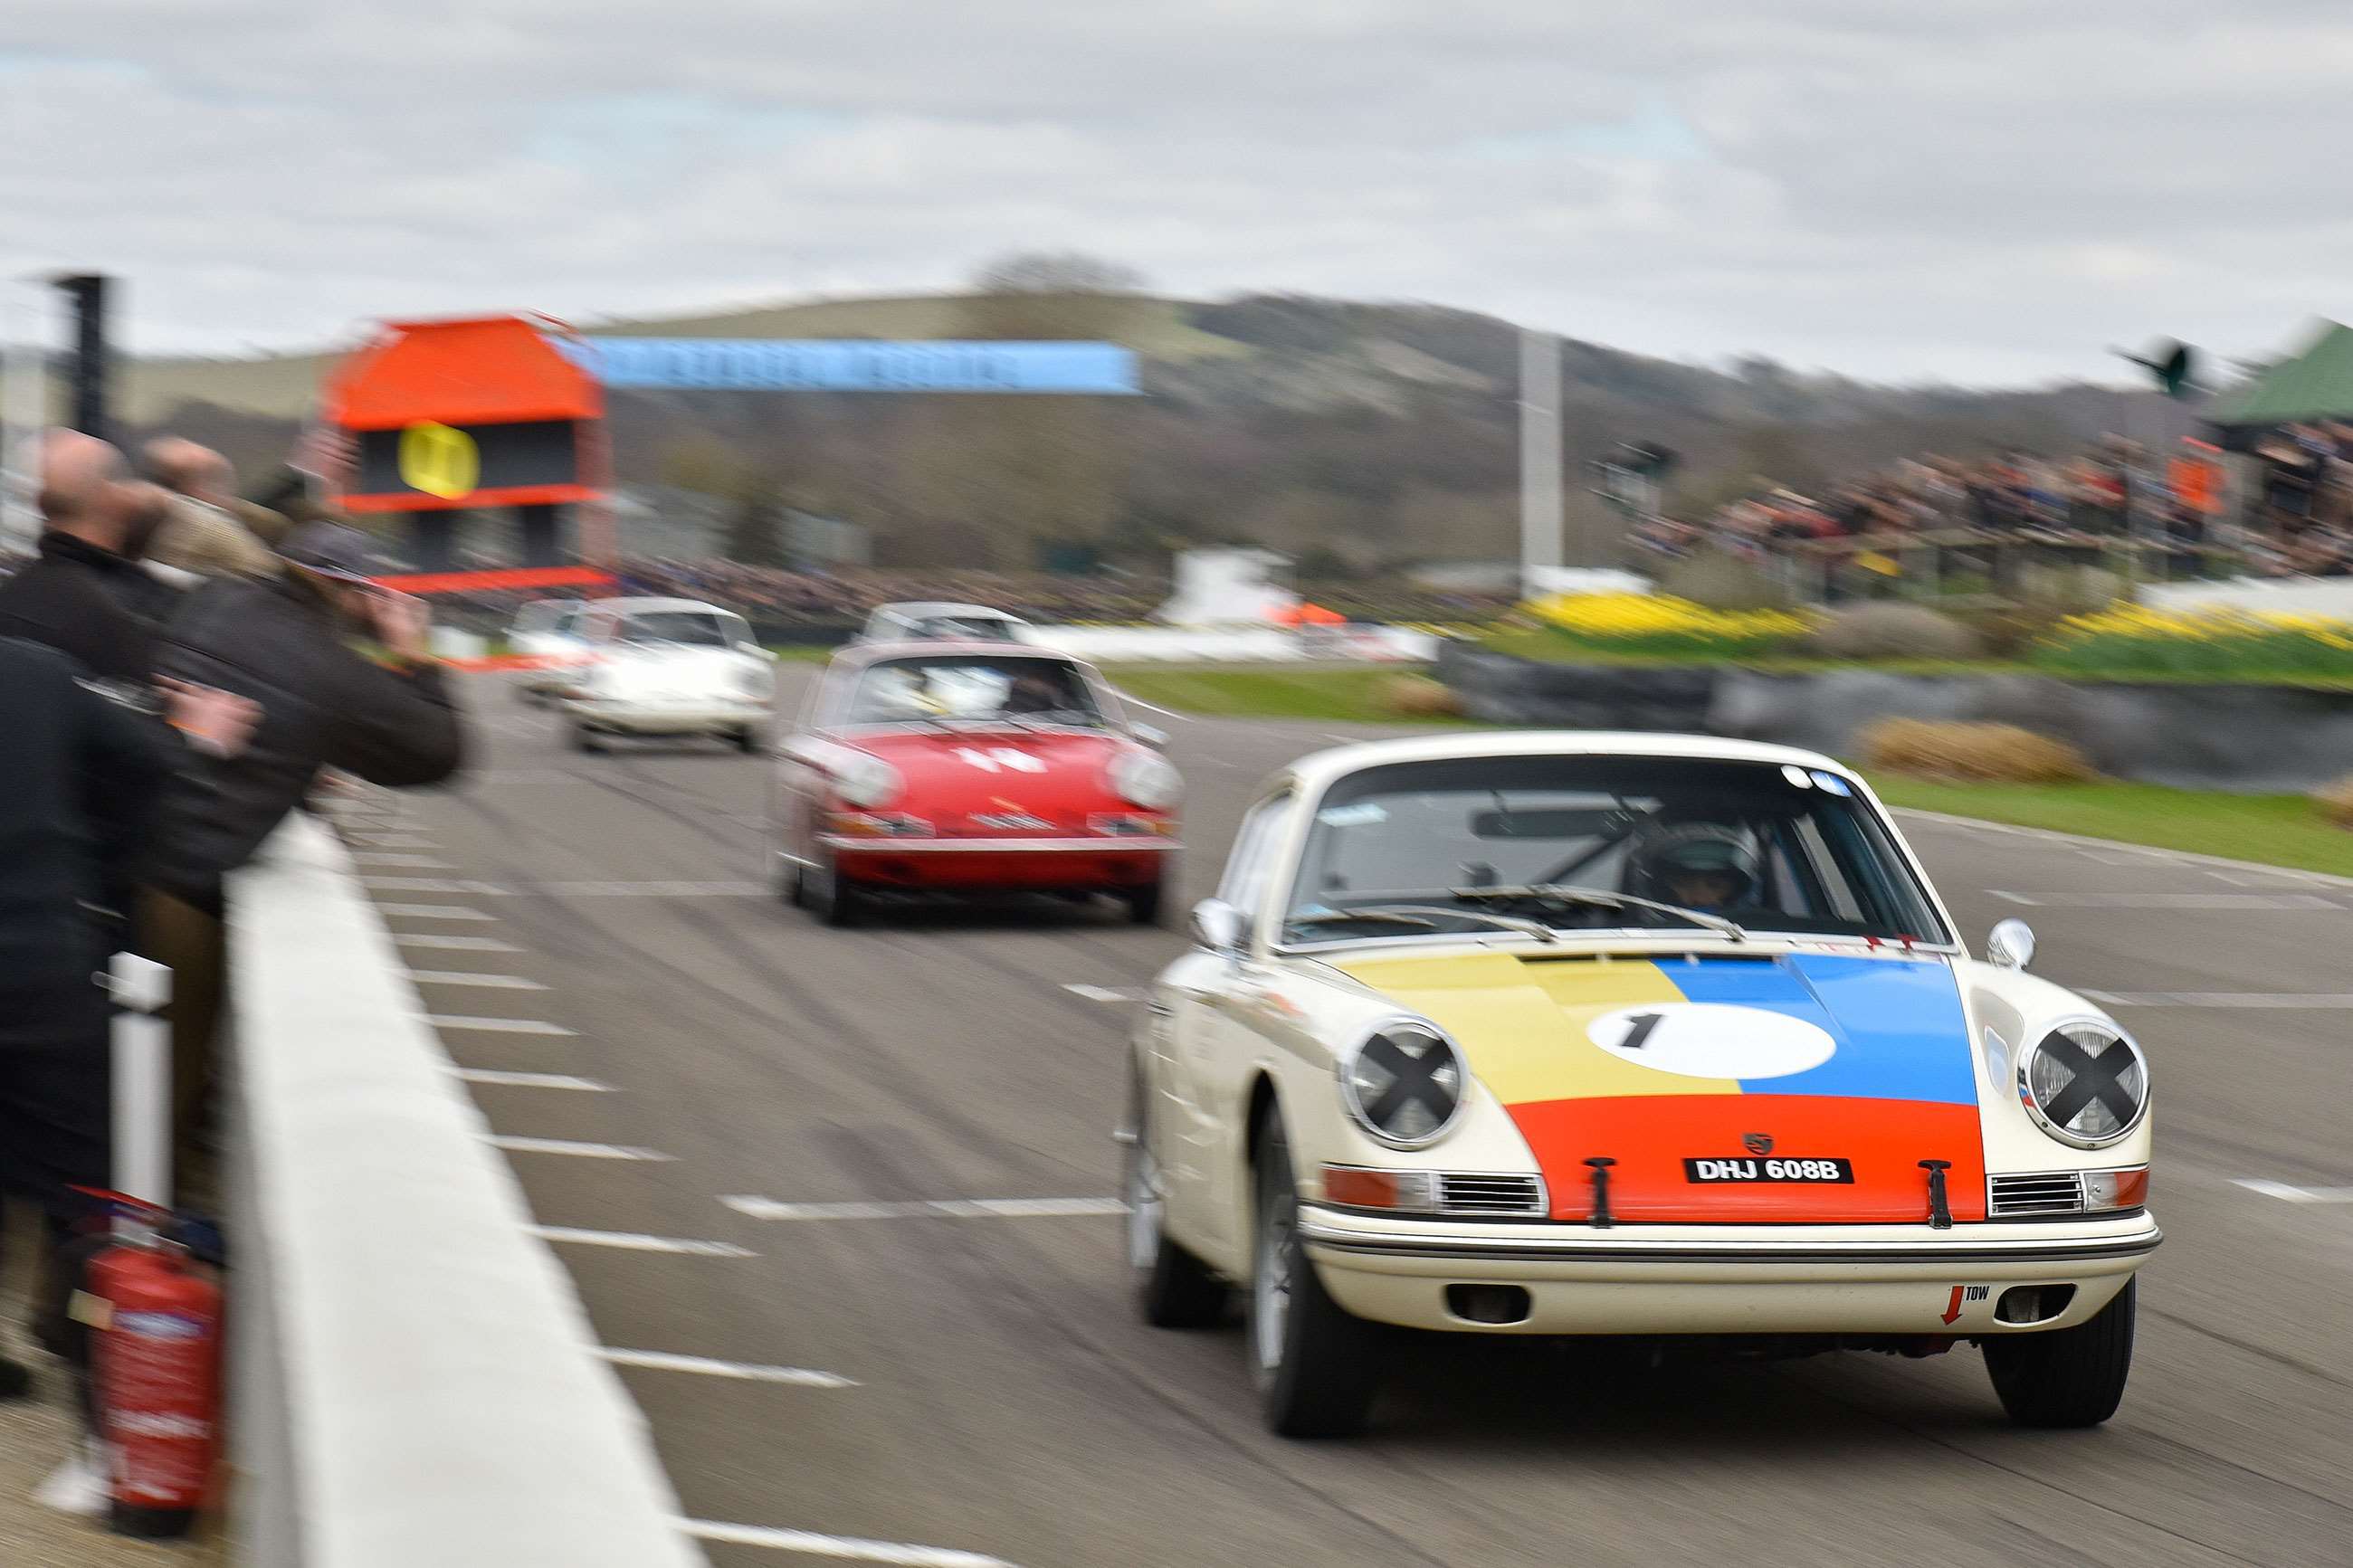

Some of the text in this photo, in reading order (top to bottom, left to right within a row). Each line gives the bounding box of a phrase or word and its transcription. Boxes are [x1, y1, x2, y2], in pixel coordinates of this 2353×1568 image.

[1620, 1013, 1663, 1049] 1
[1695, 1159, 1840, 1180] DHJ 608B
[1966, 1285, 1990, 1301] TOW
